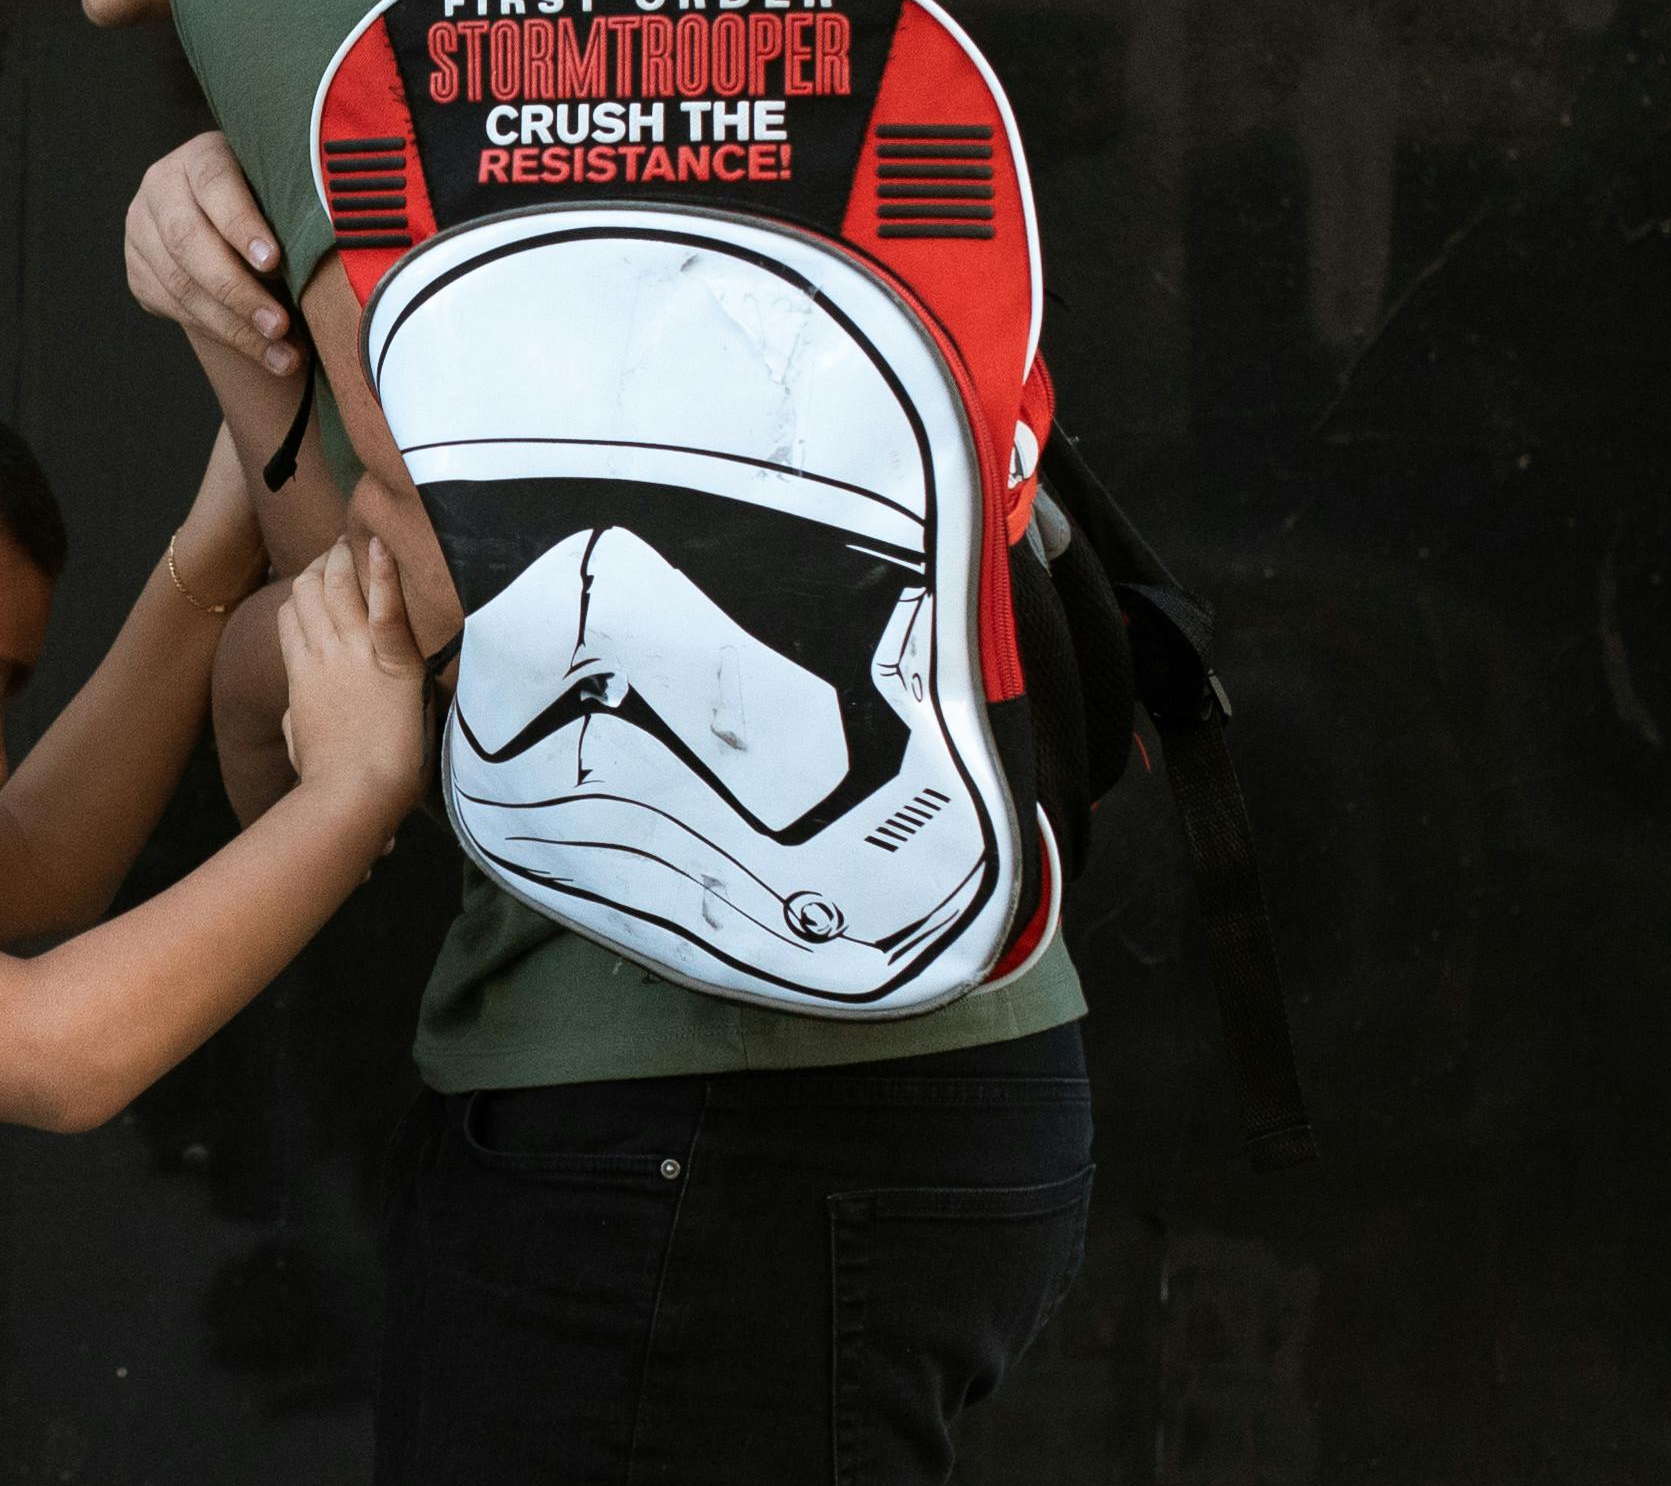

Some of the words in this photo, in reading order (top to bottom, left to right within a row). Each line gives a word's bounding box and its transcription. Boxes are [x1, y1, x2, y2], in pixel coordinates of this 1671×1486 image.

[427, 12, 851, 104] STORMTROOPER
[485, 101, 665, 146] CRUSH
[679, 100, 788, 142] THE
[478, 143, 792, 183] RESISTANCE!
